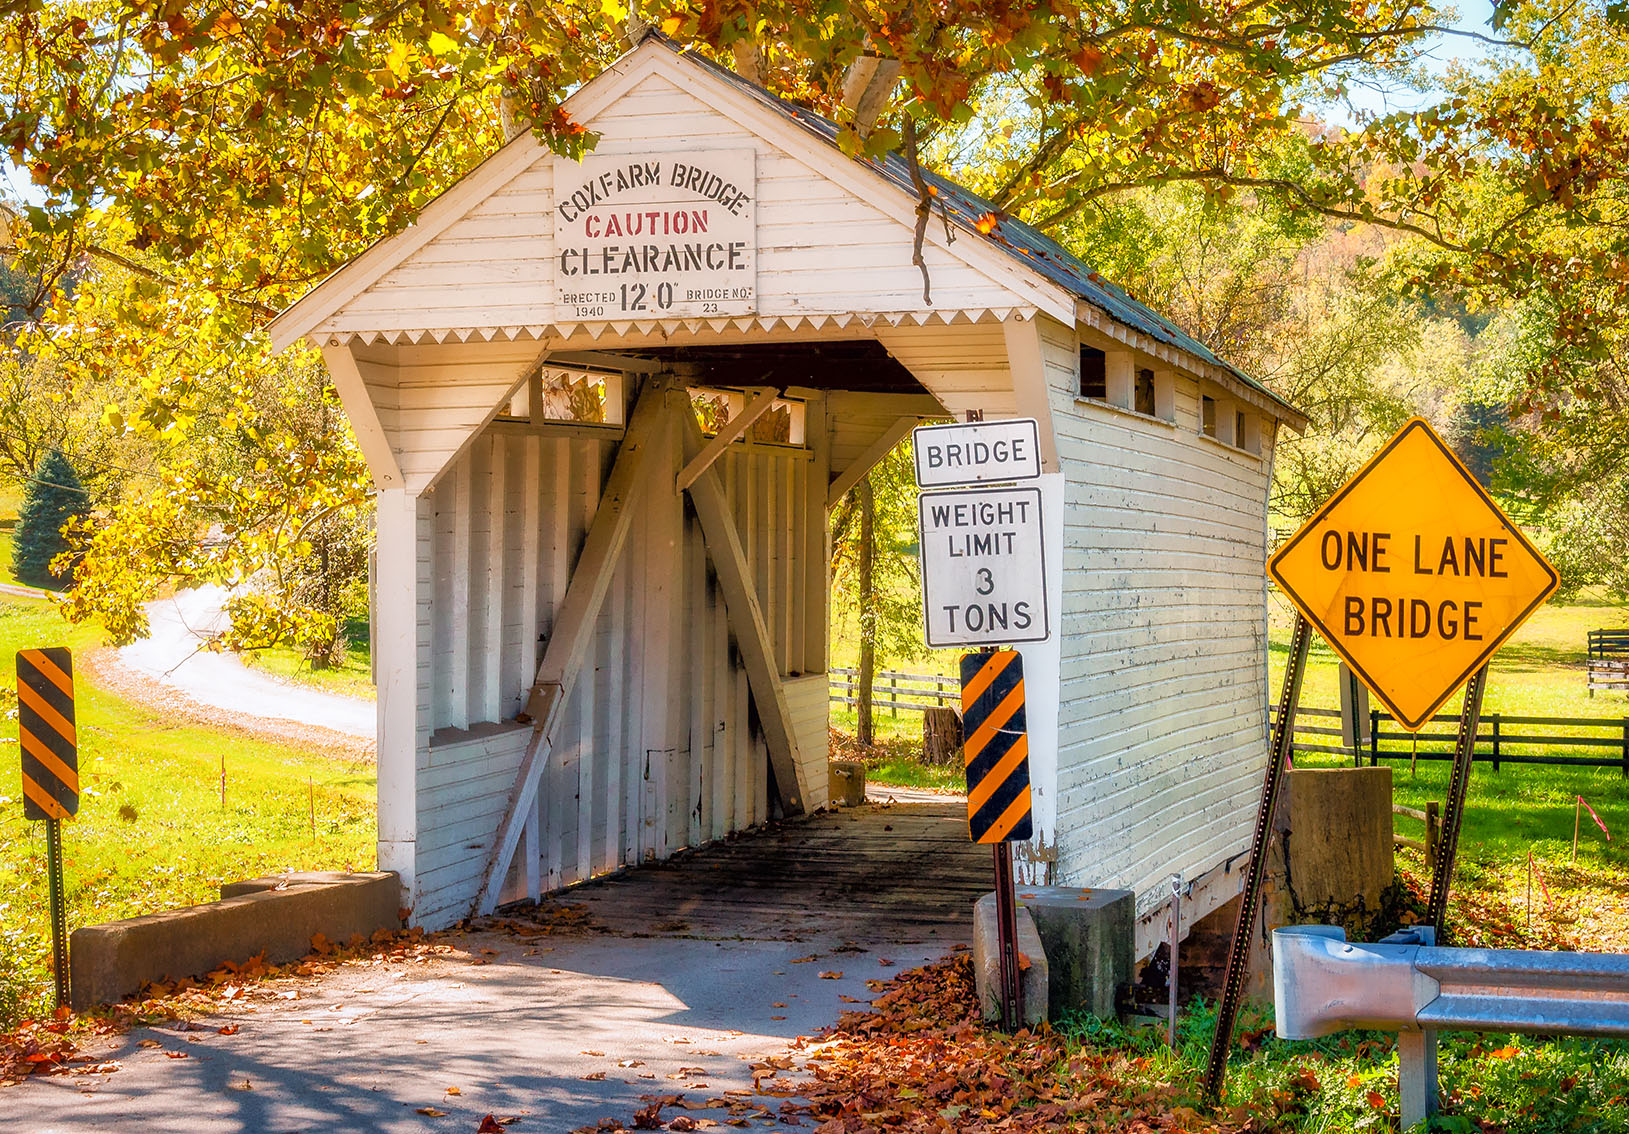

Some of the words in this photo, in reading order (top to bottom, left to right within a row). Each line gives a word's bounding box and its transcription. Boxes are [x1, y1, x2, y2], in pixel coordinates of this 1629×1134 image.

[670, 162, 750, 217] BRIDGE
[585, 209, 708, 239] CAUTION
[560, 242, 746, 276] CLEARANCE
[563, 292, 616, 304] ERECTED
[686, 288, 729, 300] BRIDGE
[702, 303, 718, 313] 23
[576, 306, 604, 317] 1940
[927, 439, 1027, 468] BRIDGE
[931, 501, 1030, 528] WEIGHT
[949, 532, 1017, 557] LIMIT
[1320, 530, 1391, 573] ONE
[1414, 535, 1508, 578] LANE
[976, 567, 994, 595] 3
[943, 601, 1032, 633] TONS
[1344, 596, 1483, 641] BRIDGE
